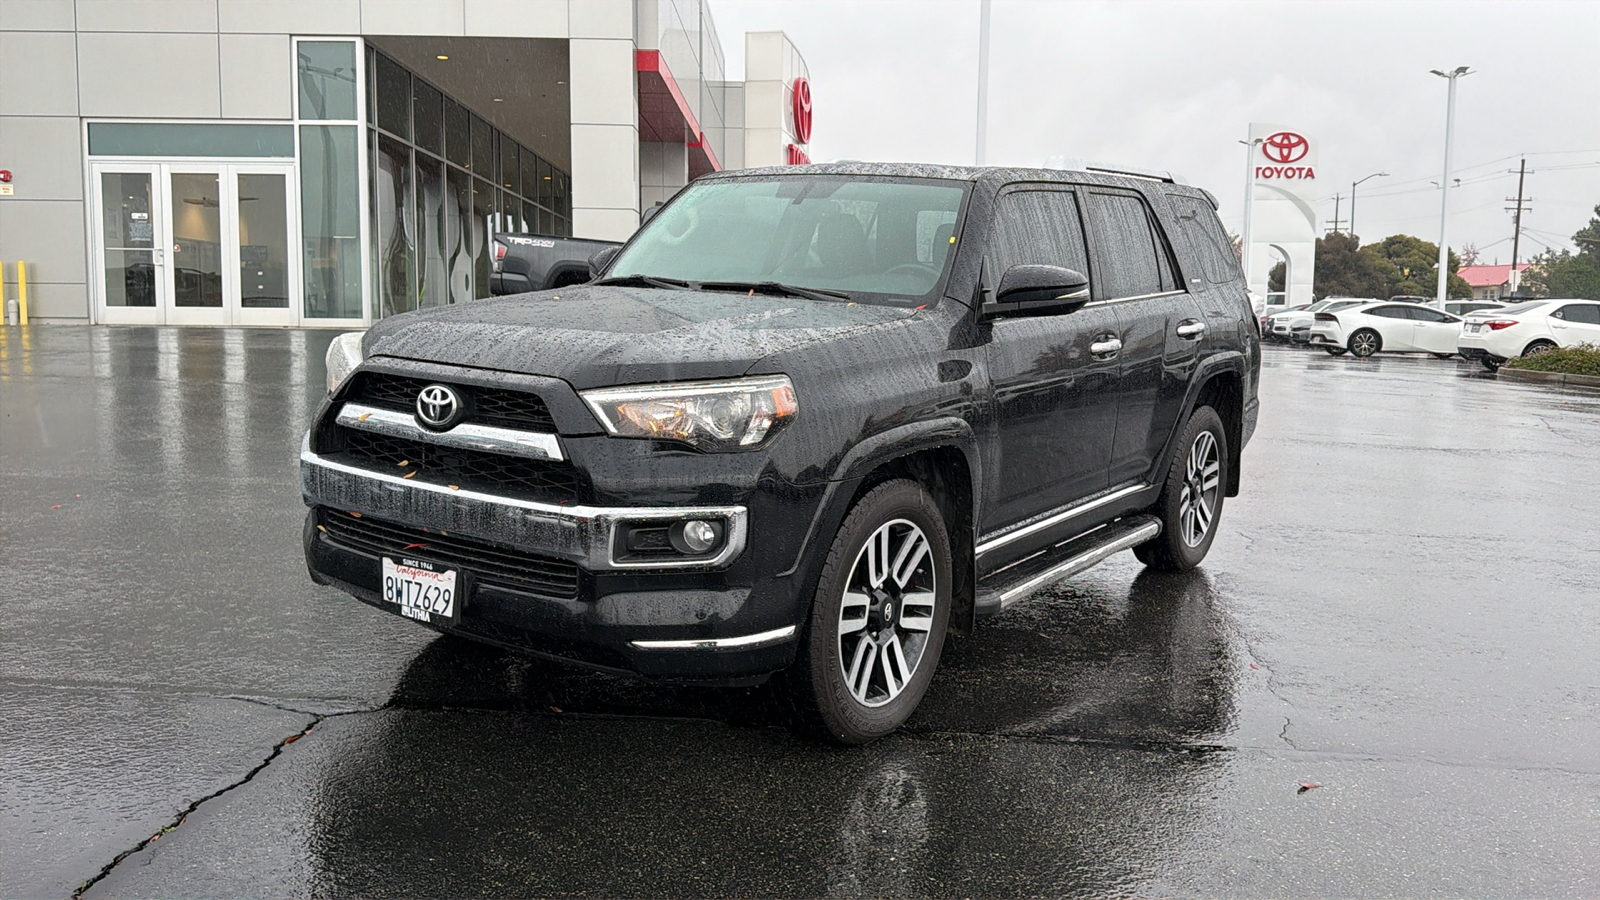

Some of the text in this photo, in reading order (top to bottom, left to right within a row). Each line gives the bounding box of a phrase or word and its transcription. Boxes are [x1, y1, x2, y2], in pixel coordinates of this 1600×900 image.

[1255, 166, 1316, 180] TOYOTA
[507, 236, 532, 245] TRD
[402, 558, 433, 571] SINCE 1946
[395, 564, 444, 582] California
[385, 575, 452, 614] 8WTZ629
